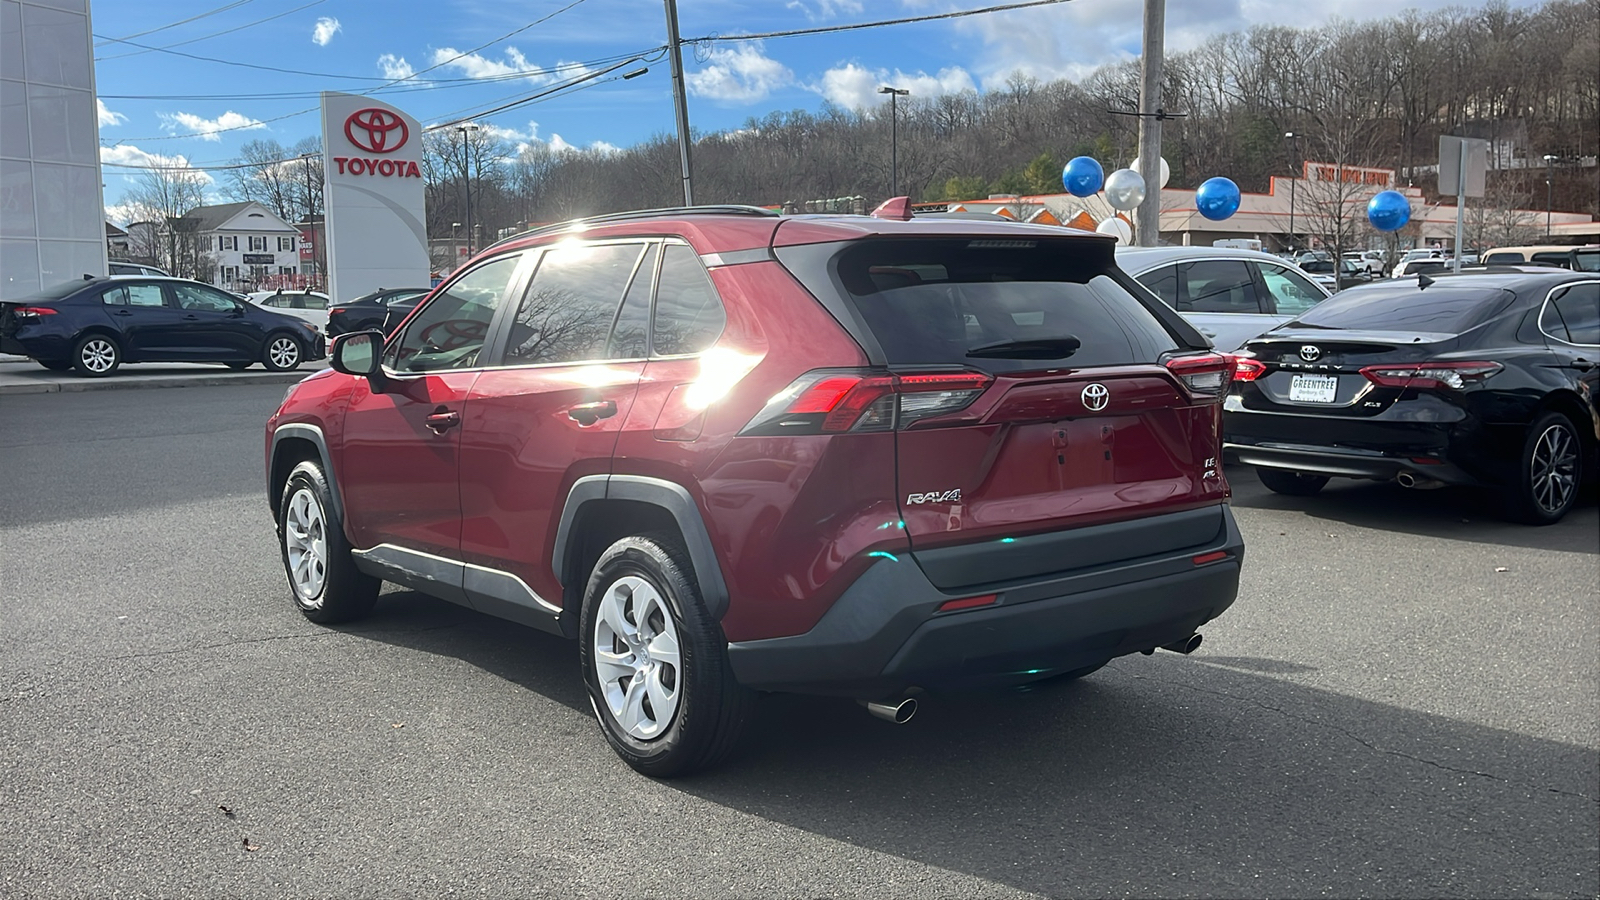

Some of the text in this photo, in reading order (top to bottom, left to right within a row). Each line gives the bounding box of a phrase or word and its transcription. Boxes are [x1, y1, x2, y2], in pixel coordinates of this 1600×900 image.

[333, 157, 421, 178] TOYOTA
[1293, 379, 1335, 390] GREENTREE
[906, 488, 962, 506] RAV4
